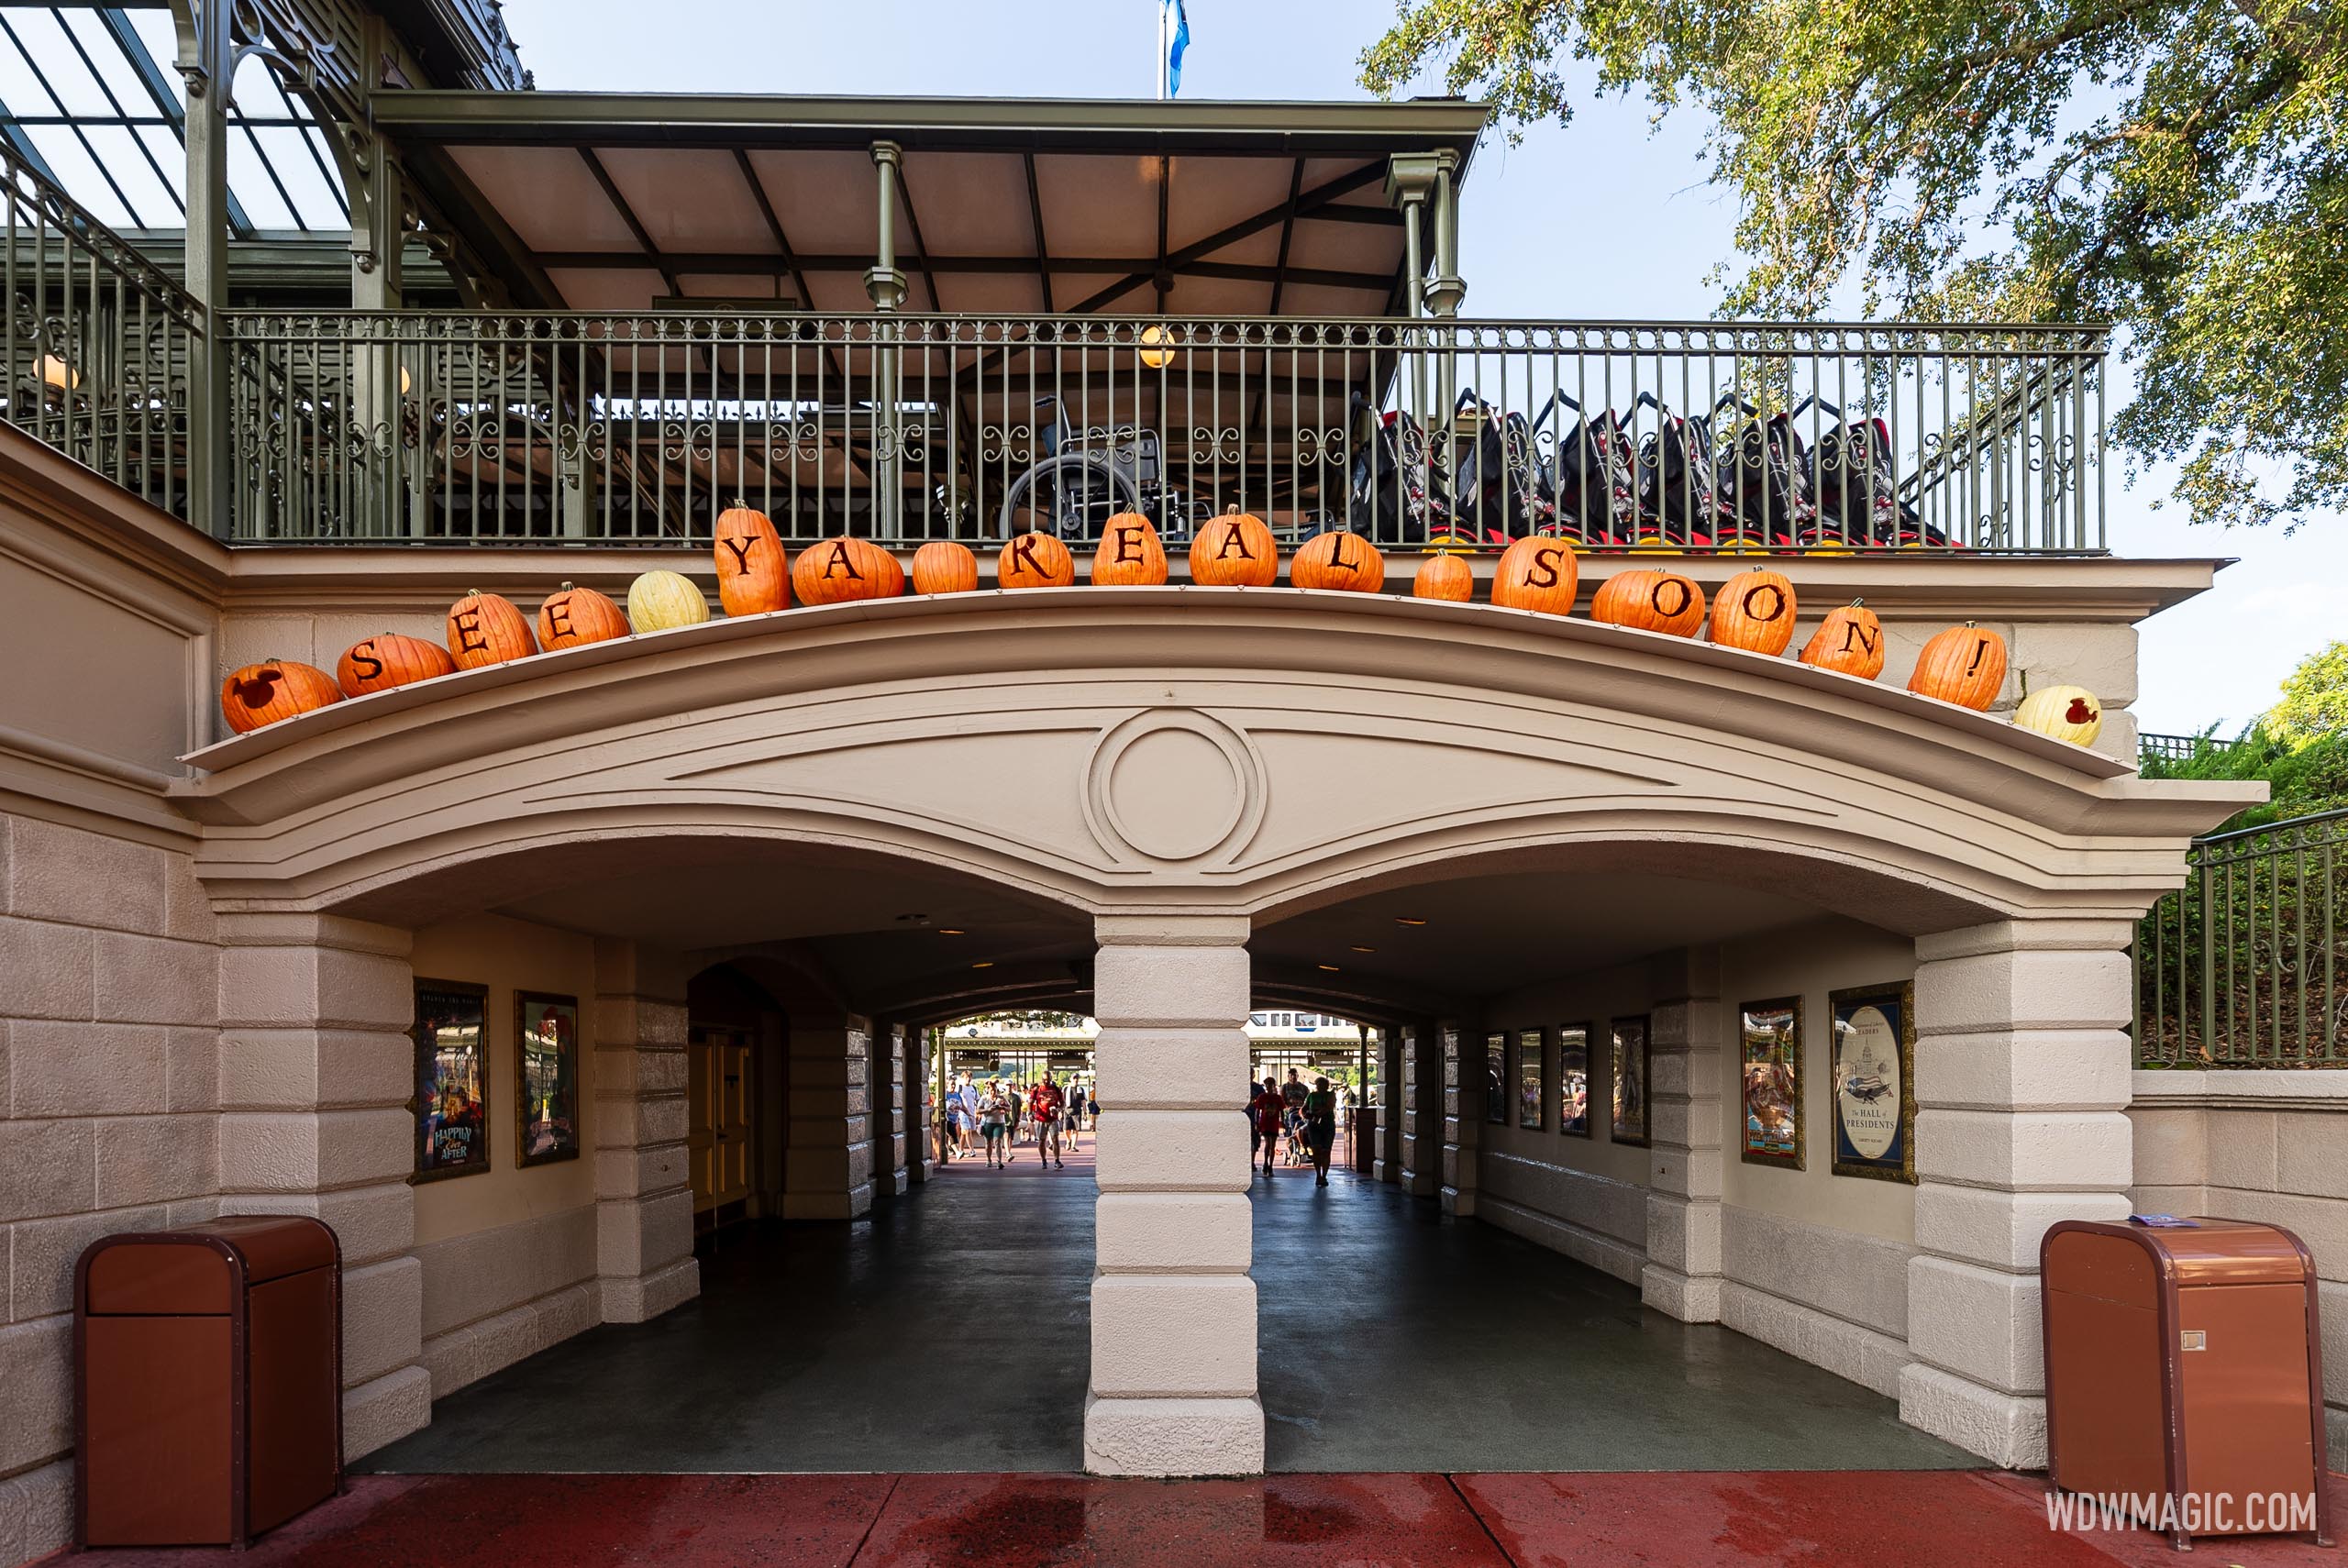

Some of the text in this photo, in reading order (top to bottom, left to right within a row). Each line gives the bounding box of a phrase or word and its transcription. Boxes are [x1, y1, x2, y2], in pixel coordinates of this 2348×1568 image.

[351, 523, 1989, 680] SEE YA REAL SOON!
[1860, 1110, 1881, 1118] HALL
[1846, 1120, 1895, 1129] PRESIDENTS
[435, 1126, 471, 1147] HAPPILY
[441, 1145, 467, 1160] AFTER
